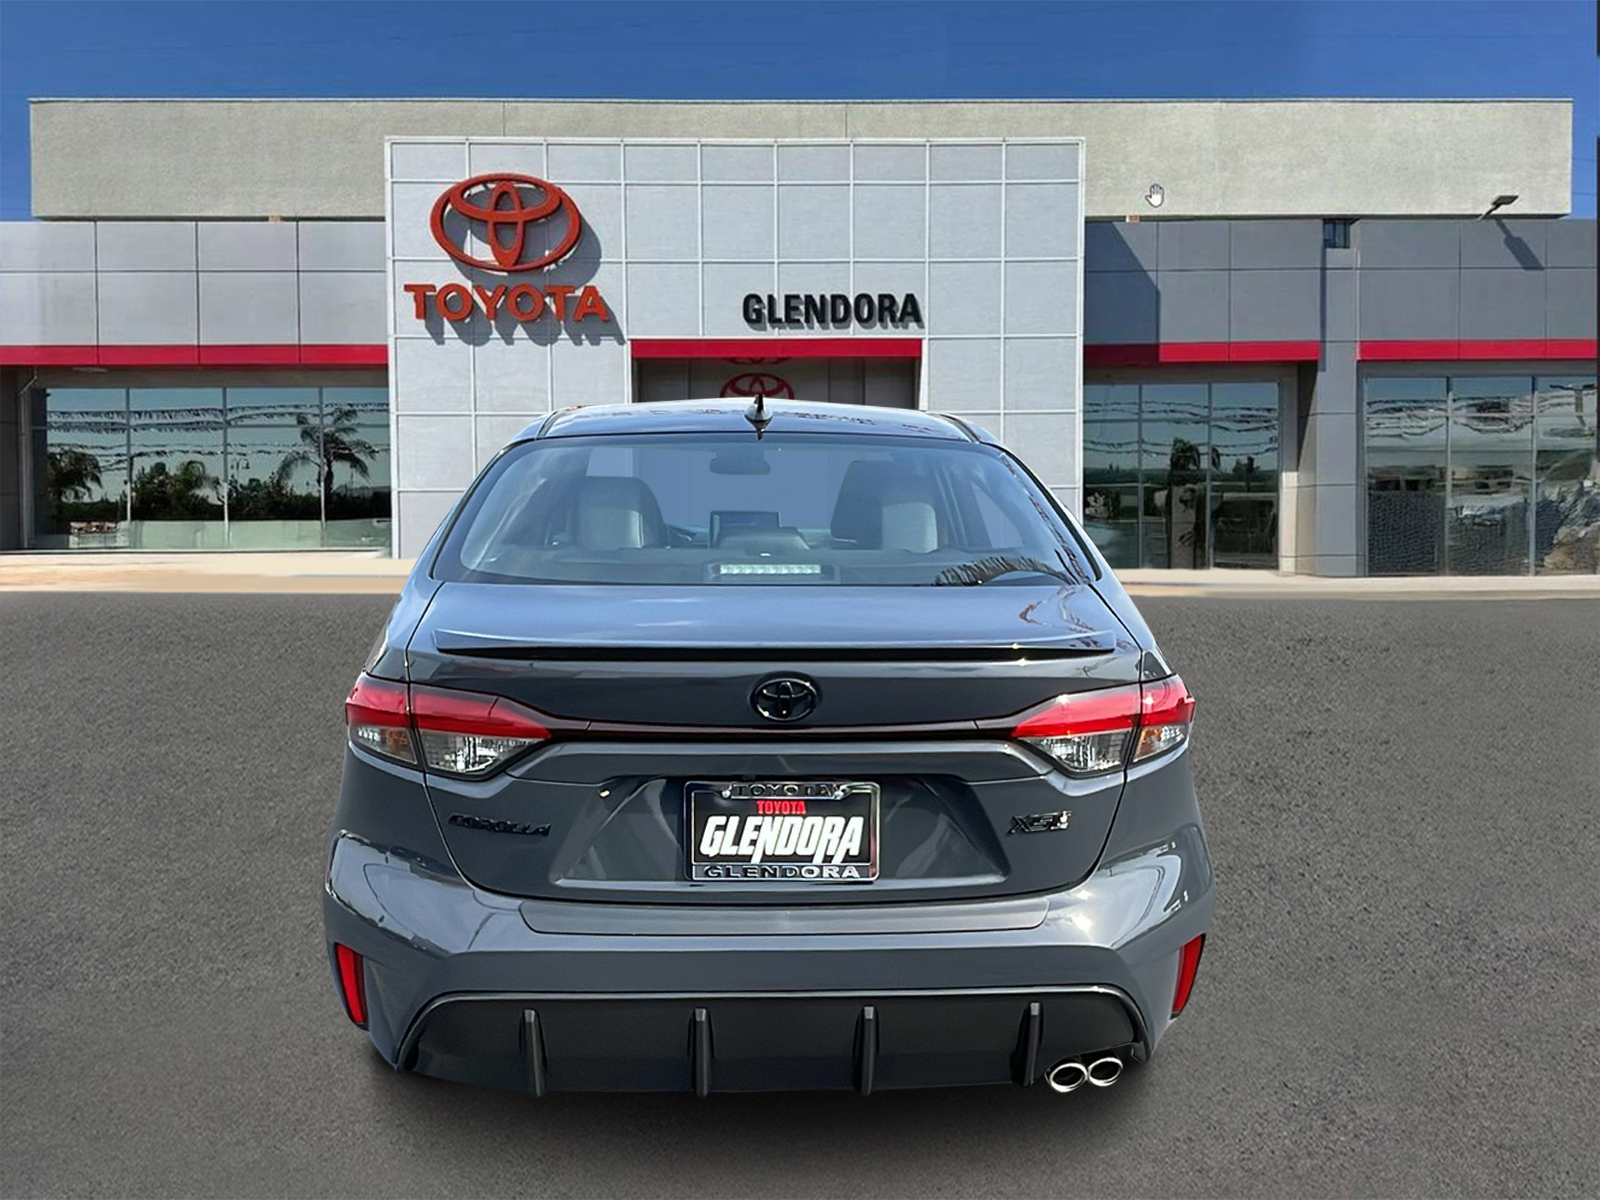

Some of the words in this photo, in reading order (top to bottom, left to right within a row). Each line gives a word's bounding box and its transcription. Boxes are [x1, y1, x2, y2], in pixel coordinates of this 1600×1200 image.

[404, 284, 611, 323] TOYOTA
[742, 293, 923, 326] GLENDORA
[732, 783, 832, 797] TOYOTA
[756, 800, 806, 815] TOYOTA
[699, 815, 864, 864] GLENDORA
[703, 865, 861, 879] GLENDORA
